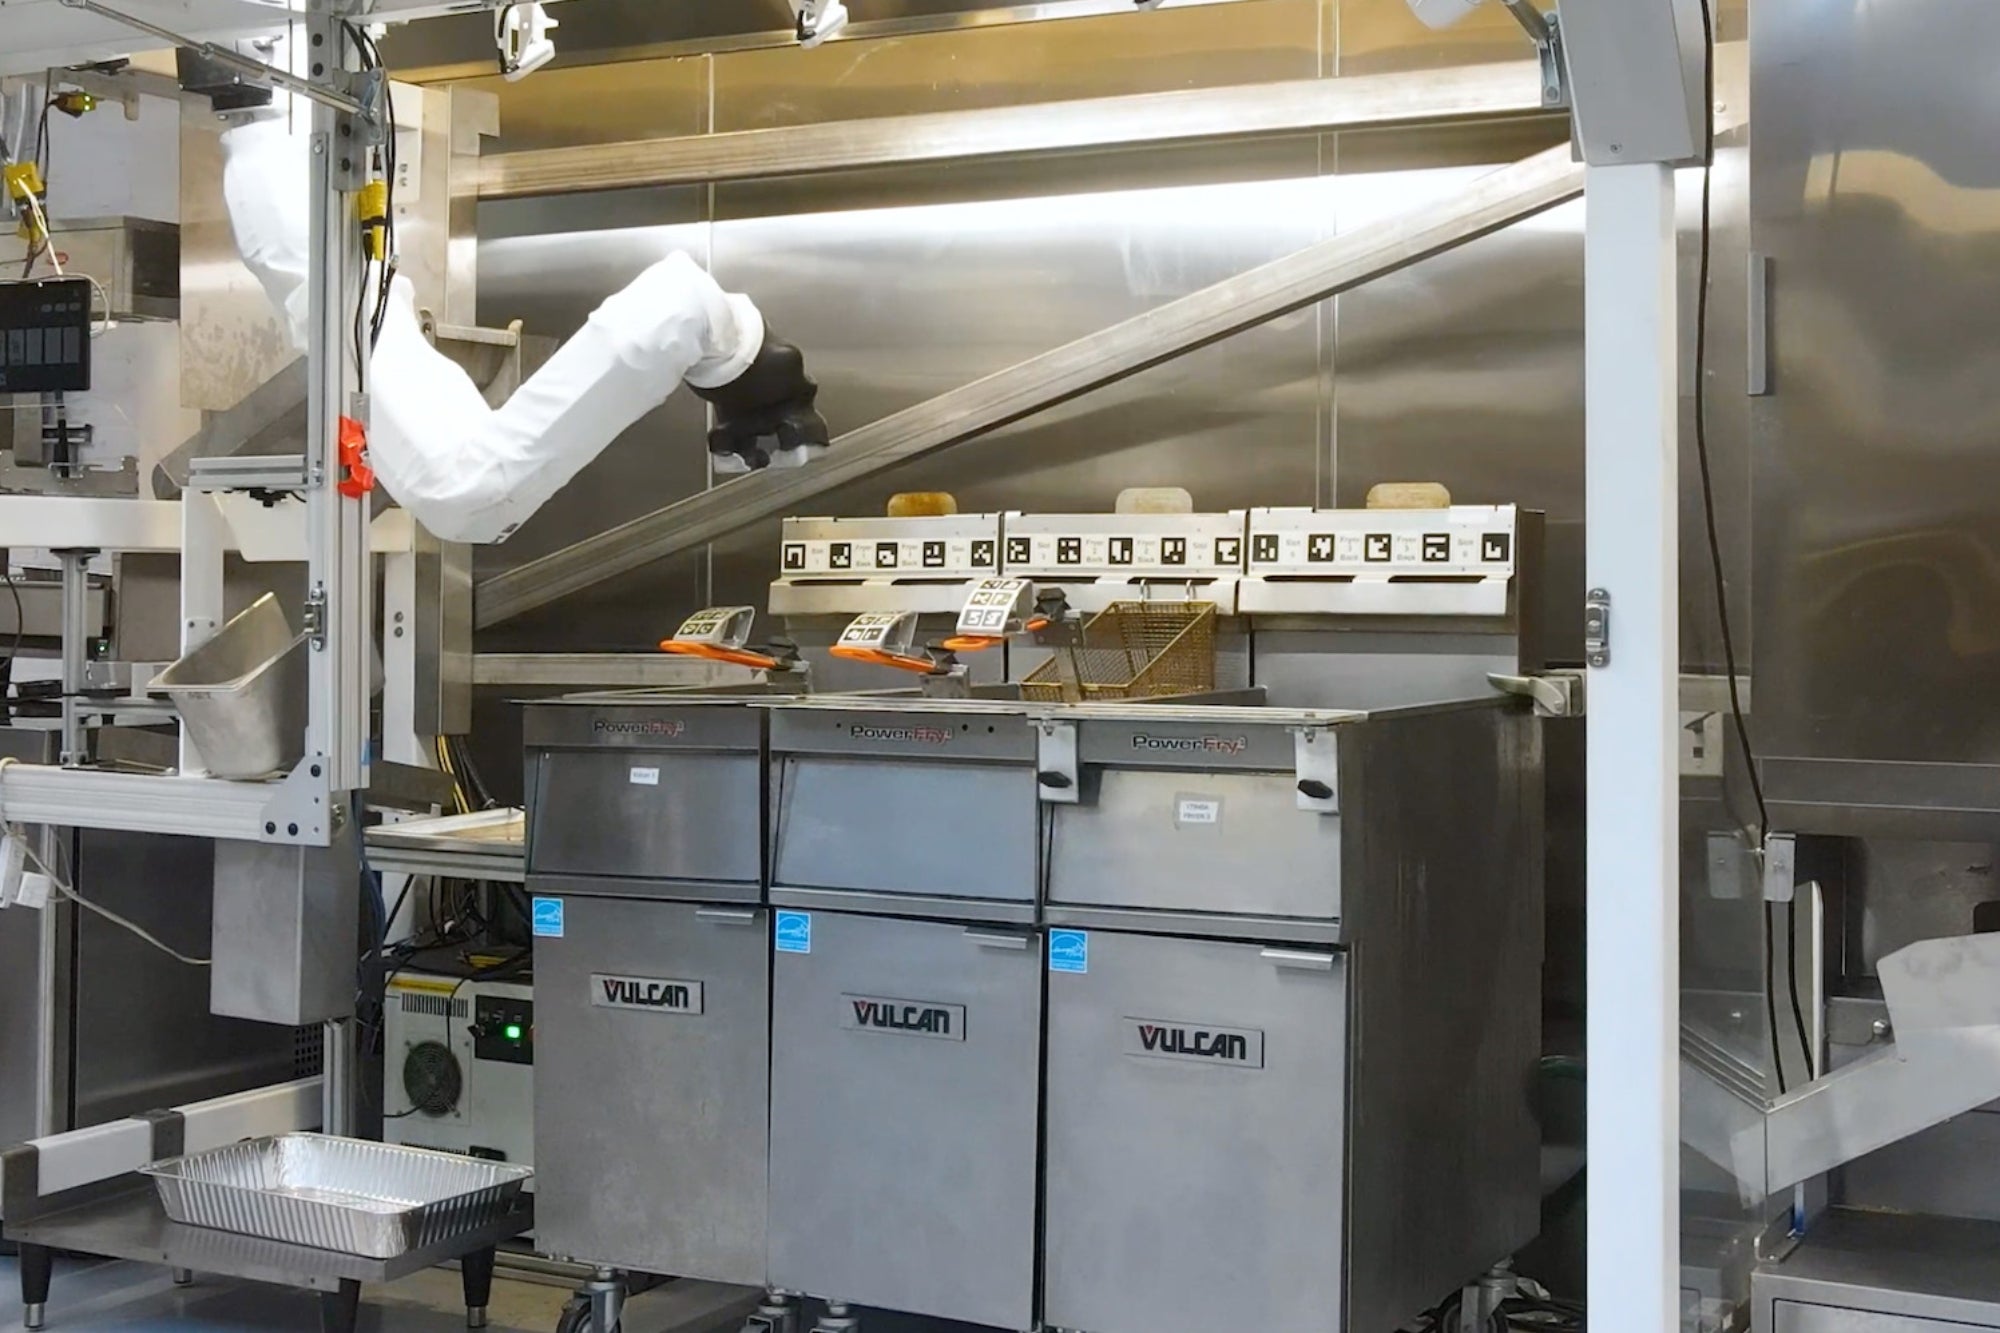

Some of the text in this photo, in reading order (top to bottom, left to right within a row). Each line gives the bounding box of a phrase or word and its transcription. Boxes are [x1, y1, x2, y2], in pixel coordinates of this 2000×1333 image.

[603, 979, 688, 1009] VULCAN
[853, 1000, 950, 1034] VULCAN
[1138, 1025, 1246, 1060] VULCAN
